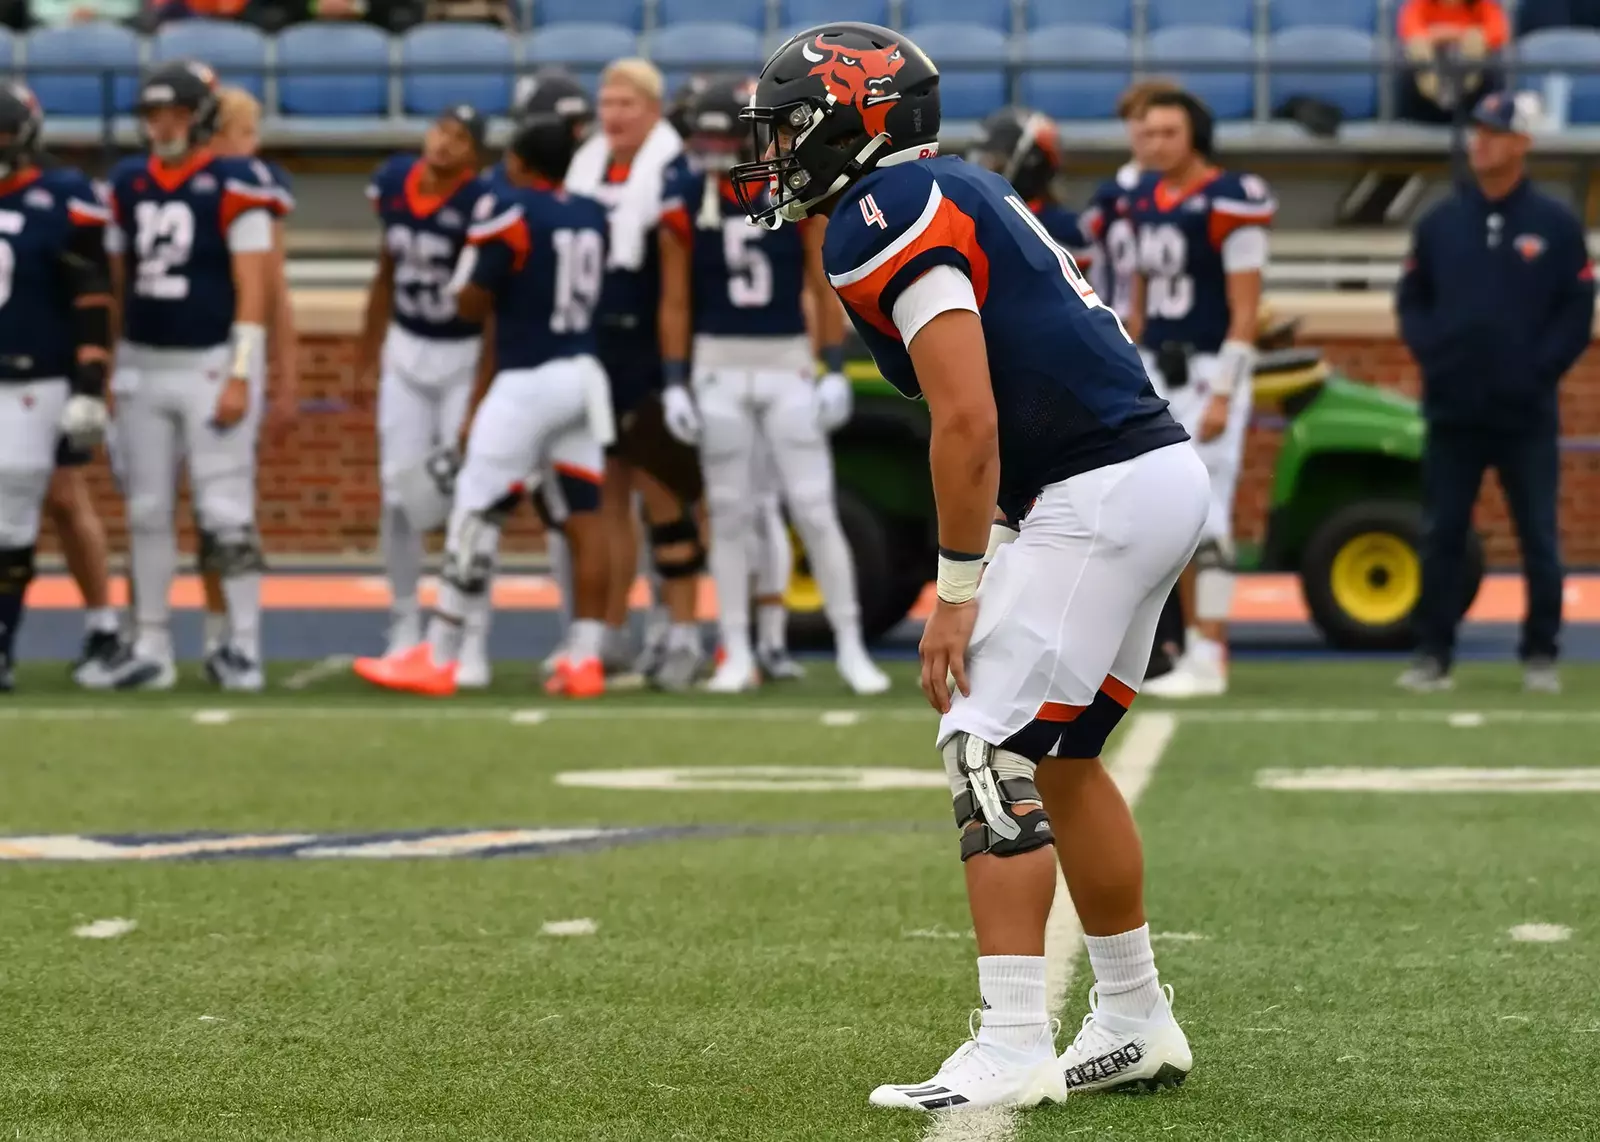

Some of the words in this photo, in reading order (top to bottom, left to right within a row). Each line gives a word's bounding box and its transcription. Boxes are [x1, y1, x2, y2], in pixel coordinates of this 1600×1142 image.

[134, 200, 195, 300] 12
[859, 193, 888, 230] 4
[549, 226, 603, 334] 19
[722, 215, 773, 308] 5
